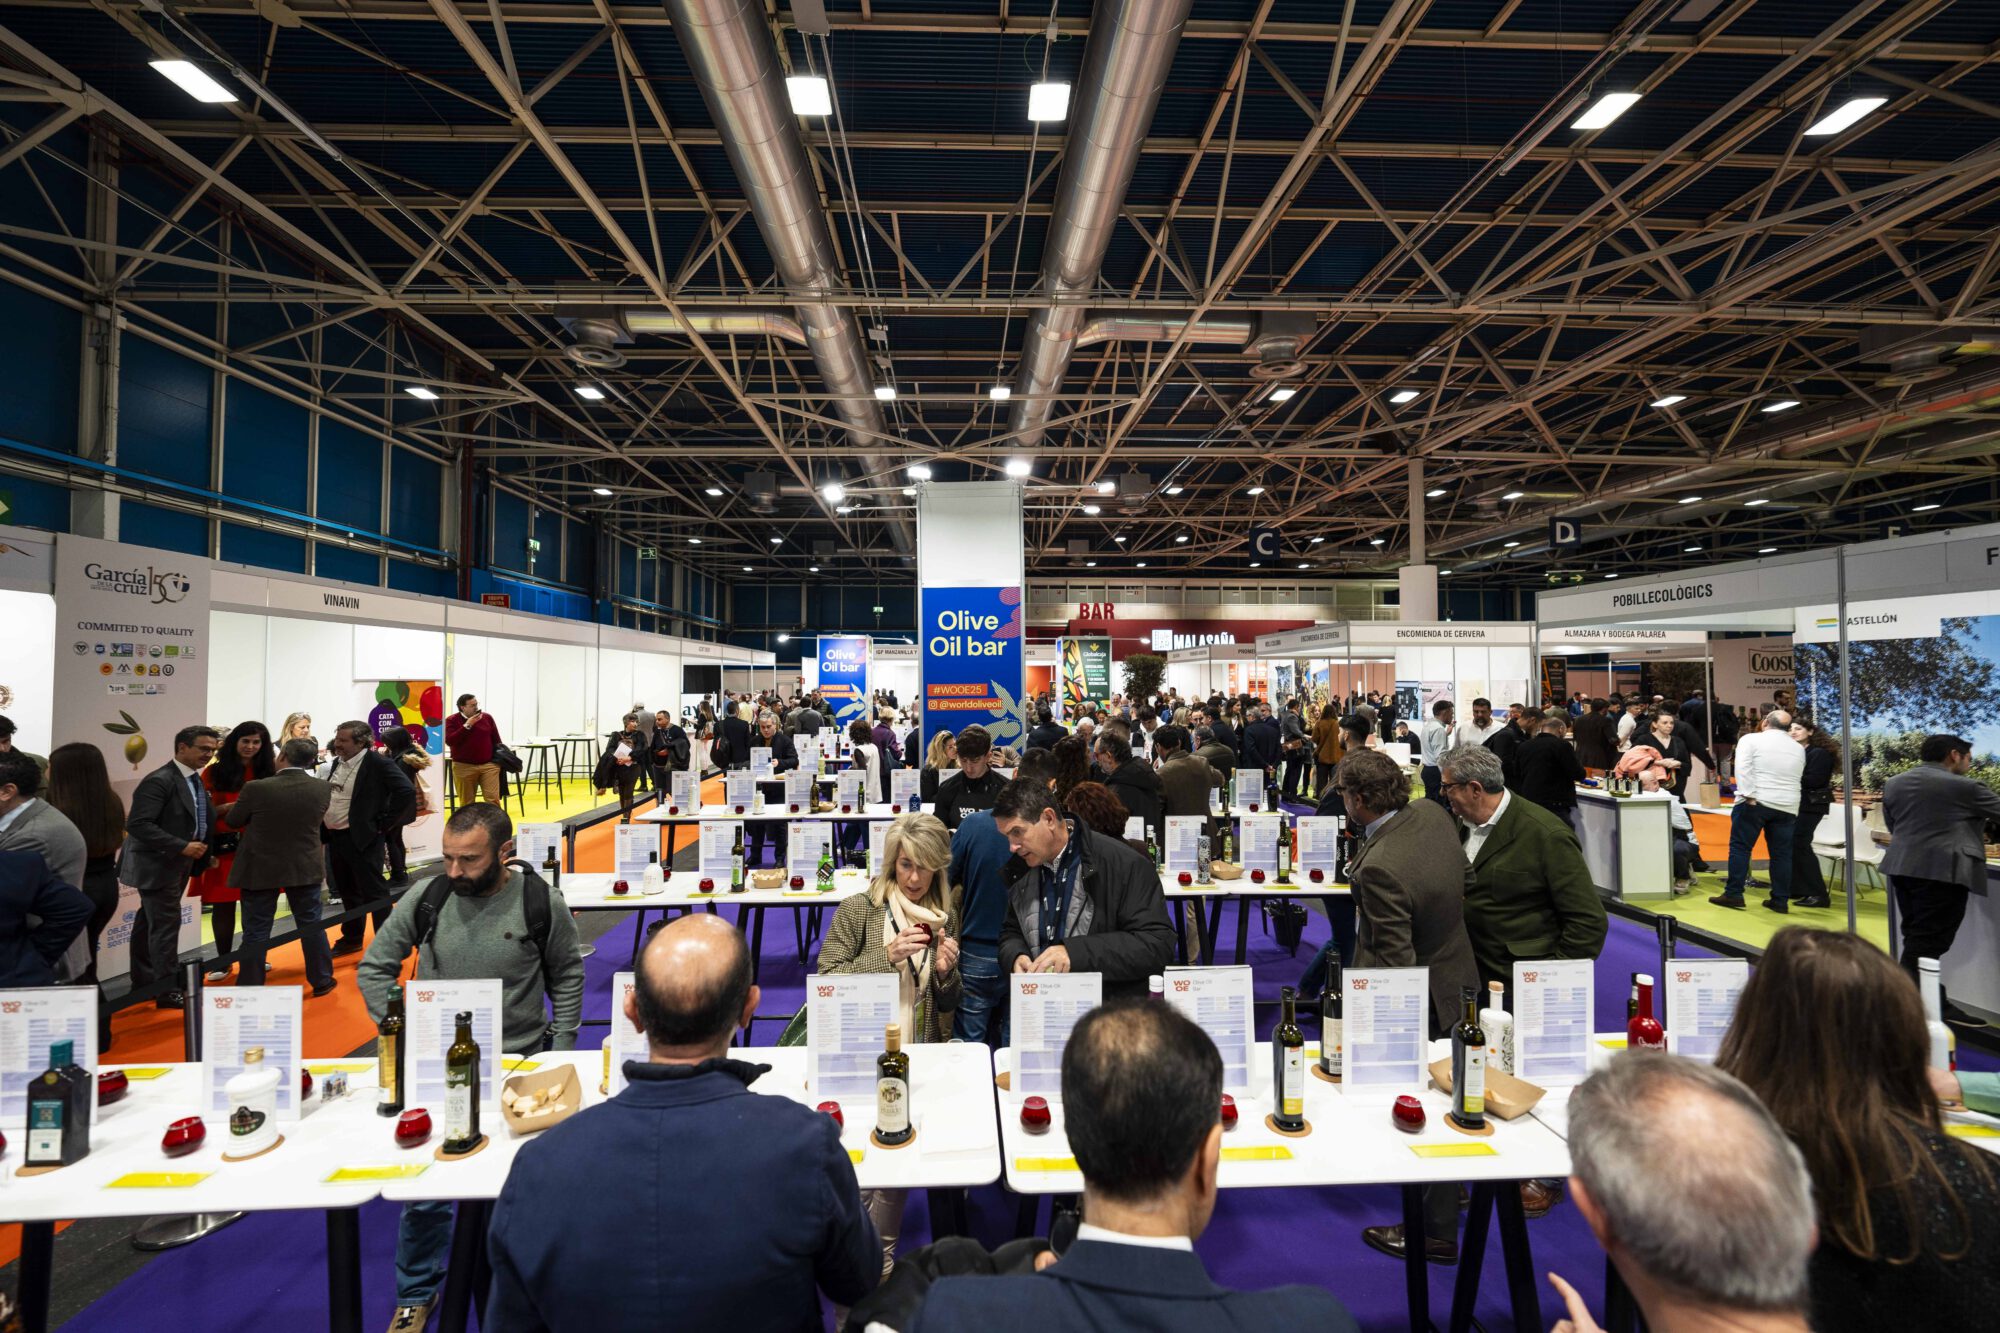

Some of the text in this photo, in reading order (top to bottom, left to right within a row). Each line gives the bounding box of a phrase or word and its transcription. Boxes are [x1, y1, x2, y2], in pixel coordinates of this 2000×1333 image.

[1555, 522, 1575, 544] D
[1256, 532, 1274, 556] C
[84, 563, 147, 586] García
[114, 582, 148, 596] cruz
[1612, 584, 1713, 608] POBILLECOLÒGICS
[323, 593, 360, 610] VINAVIN
[1079, 602, 1115, 620] BAR
[938, 610, 999, 630] Olive
[1846, 614, 1898, 626] ASTELLÓN
[78, 622, 194, 637] COMMITED TO QUALITY
[826, 650, 856, 659] Olive
[930, 636, 1008, 656] Oil bar
[822, 662, 860, 672] Oil bar
[934, 686, 982, 694] #WOOE25
